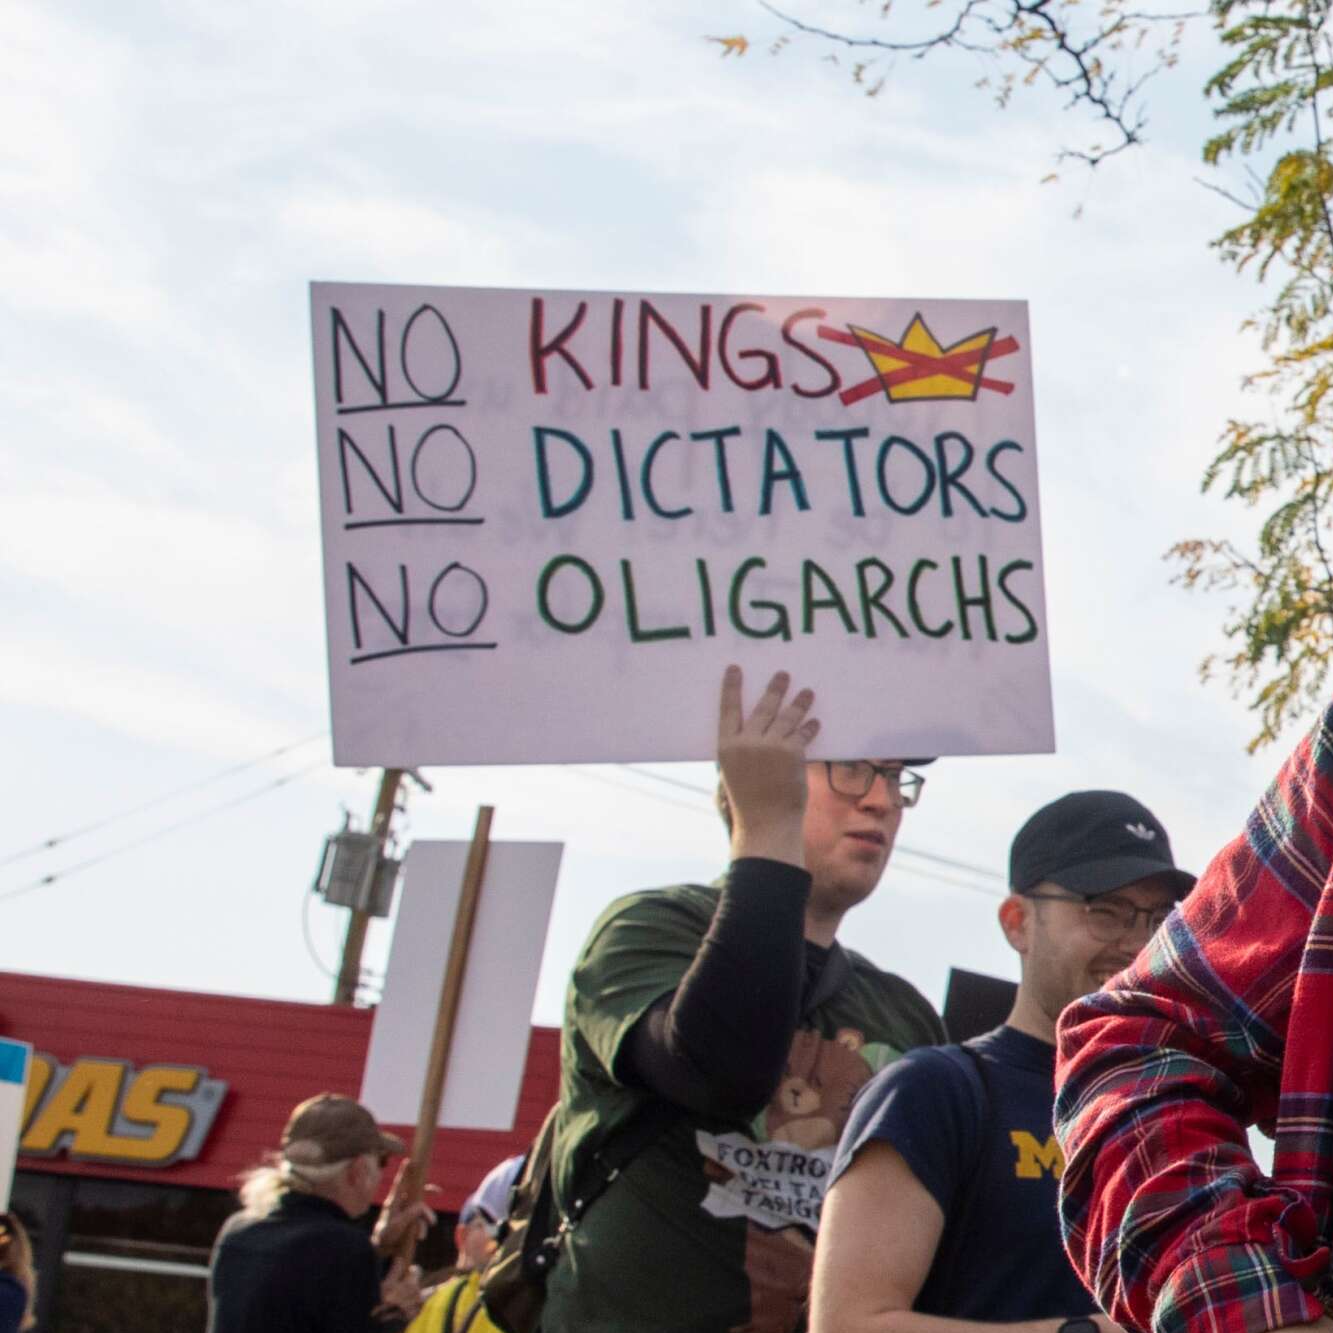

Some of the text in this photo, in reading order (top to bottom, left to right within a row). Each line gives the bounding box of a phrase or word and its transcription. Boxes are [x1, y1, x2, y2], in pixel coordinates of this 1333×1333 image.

[331, 297, 842, 405] NO KINGS
[337, 424, 1027, 522] NO DICTATORS
[347, 553, 1038, 650] NO OLIGARCHS
[718, 1142, 833, 1178] FOXTRO
[1010, 1130, 1066, 1179] M
